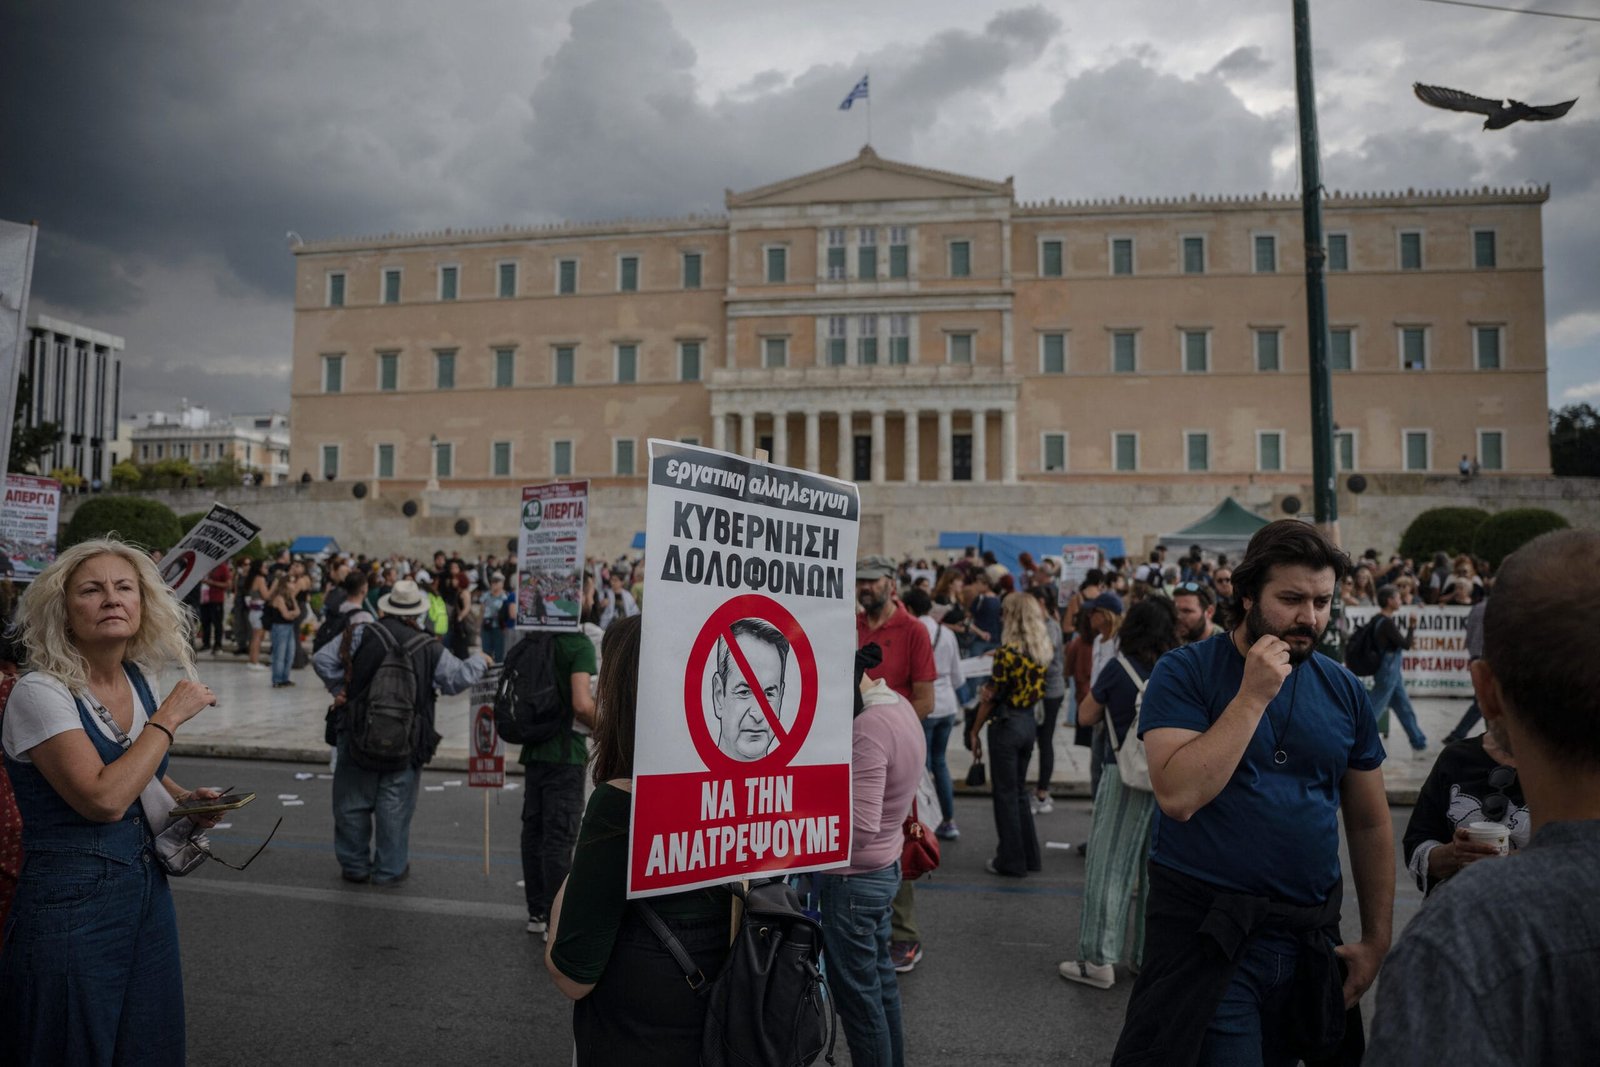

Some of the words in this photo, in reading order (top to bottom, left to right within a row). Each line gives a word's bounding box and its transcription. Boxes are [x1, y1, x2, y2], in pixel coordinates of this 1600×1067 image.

[5, 489, 55, 505] ΑΠΕΡΓΙΑ
[666, 459, 745, 496] εργατικη
[749, 475, 849, 515] αλληλεγγυη
[544, 501, 584, 520] ΑΠΕΡΓΙΑ
[673, 500, 840, 560] ΚΥΒΕΡΝΗΣΗ
[660, 544, 844, 599] ΔΟΛΟΦΟΝΩΝ
[1411, 636, 1467, 650] ΕΙΣΙΜΑΤ
[1418, 615, 1467, 630] ΔΙΩΤΙΚ
[700, 779, 735, 821] ΝΑ
[745, 775, 794, 815] ΤΗΝ
[645, 815, 840, 877] ΑΝΑΤΡΕΨΟΥΜΕ
